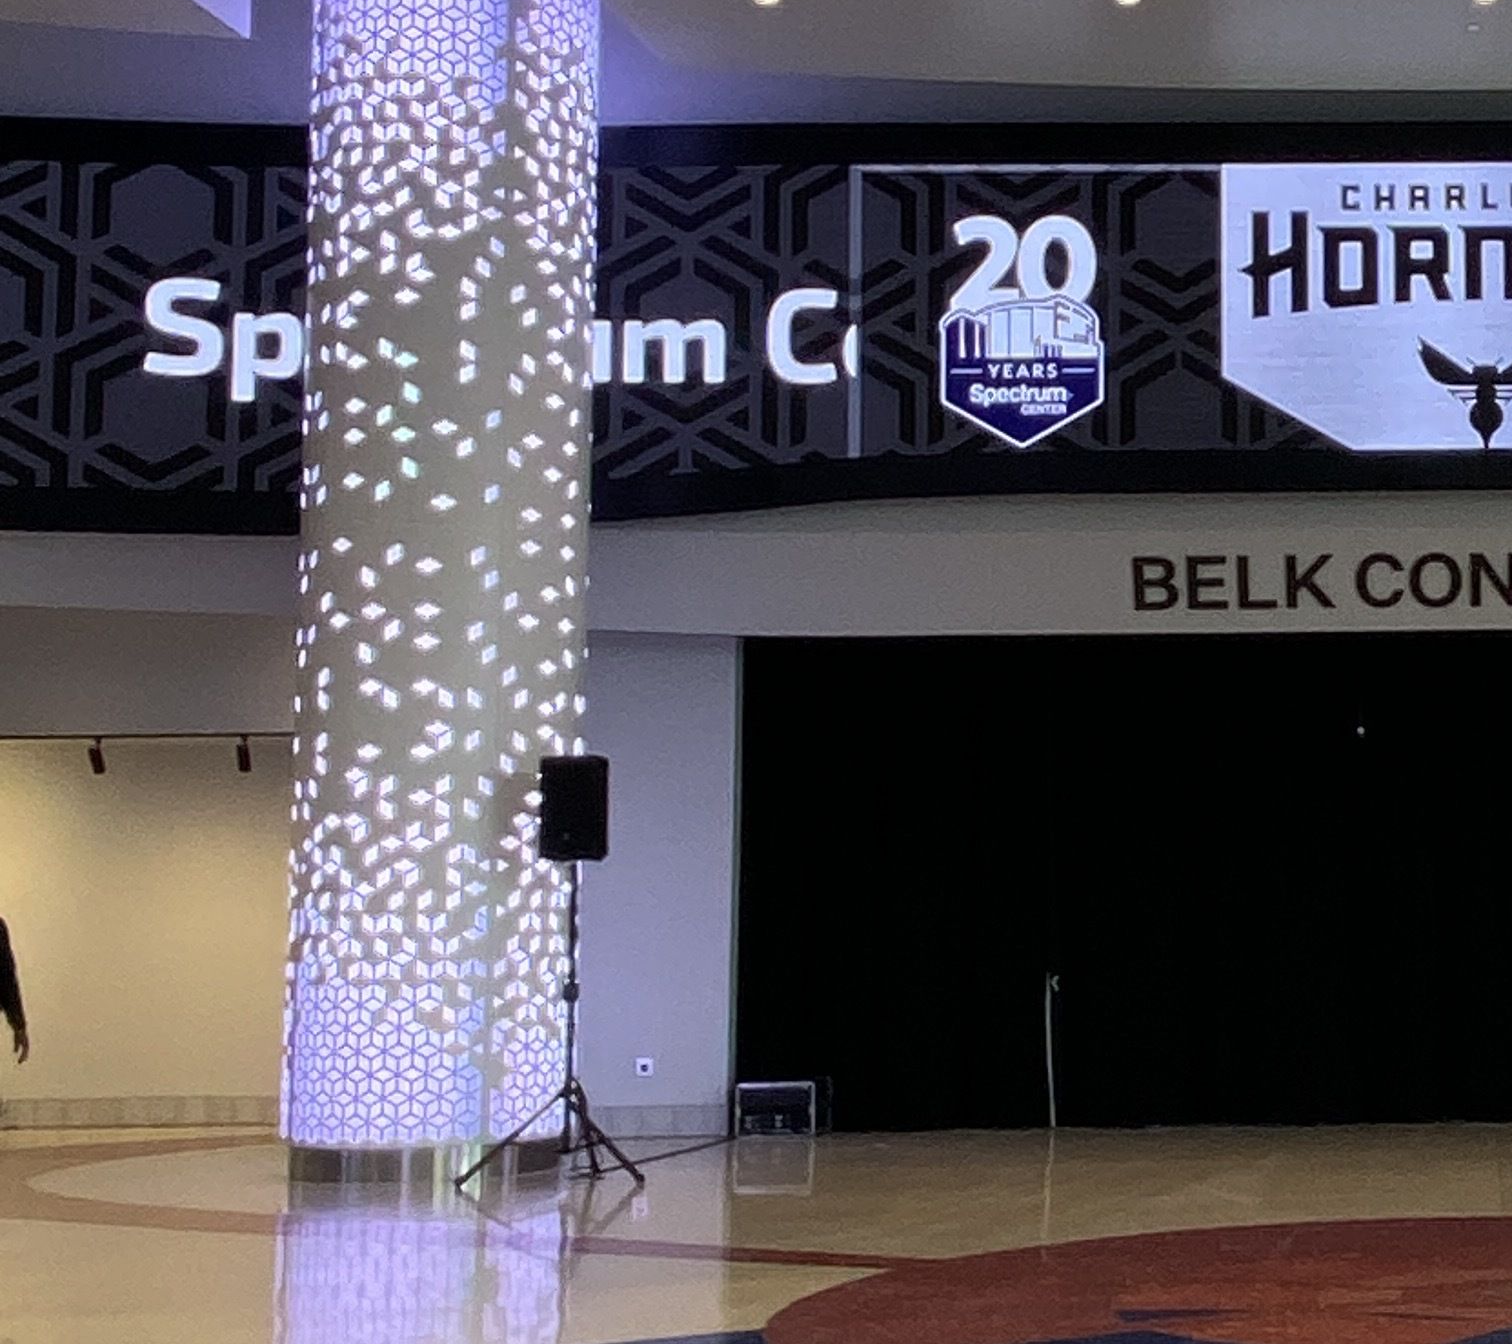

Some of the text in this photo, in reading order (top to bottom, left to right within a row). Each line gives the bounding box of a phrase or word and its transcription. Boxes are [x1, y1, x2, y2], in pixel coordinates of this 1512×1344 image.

[952, 214, 1098, 312] 20
[987, 363, 1059, 379] YEARS
[968, 383, 1067, 408] Spectrum
[1131, 553, 1336, 612] BELK
